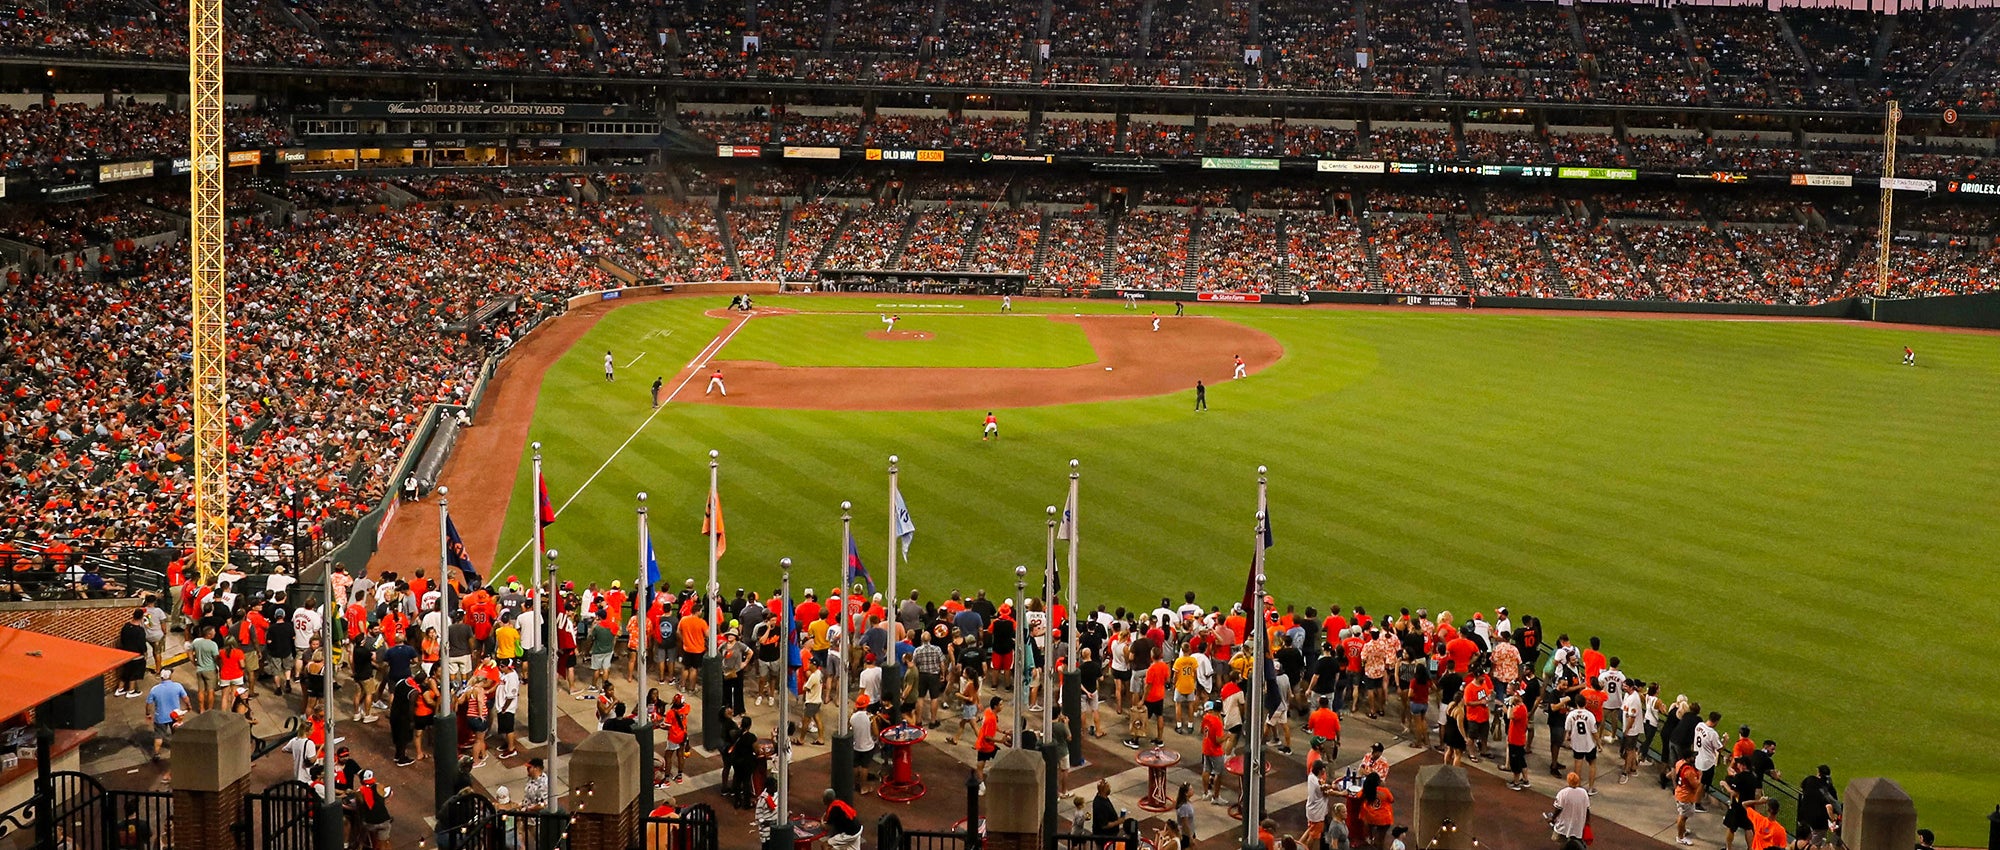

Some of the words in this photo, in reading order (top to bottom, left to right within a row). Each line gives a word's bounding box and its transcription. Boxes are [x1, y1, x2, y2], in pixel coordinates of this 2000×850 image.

[421, 104, 456, 114] ORIOLE
[457, 105, 482, 114] PARK
[491, 105, 532, 114] CAMDEN
[533, 105, 565, 115] YARDS
[285, 152, 305, 161] Fanatics
[882, 151, 898, 160] OLD
[899, 151, 915, 160] BAY
[919, 152, 942, 161] SEASON
[1563, 169, 1589, 178] advantage
[1611, 170, 1632, 179] graphics
[1406, 296, 1421, 306] Lite
[295, 619, 307, 631] 35
[395, 623, 404, 634] 2
[1524, 636, 1535, 648] 10
[1182, 667, 1192, 676] 50
[1608, 682, 1617, 693] 8
[1577, 721, 1586, 735] 8
[1696, 736, 1702, 748] 8
